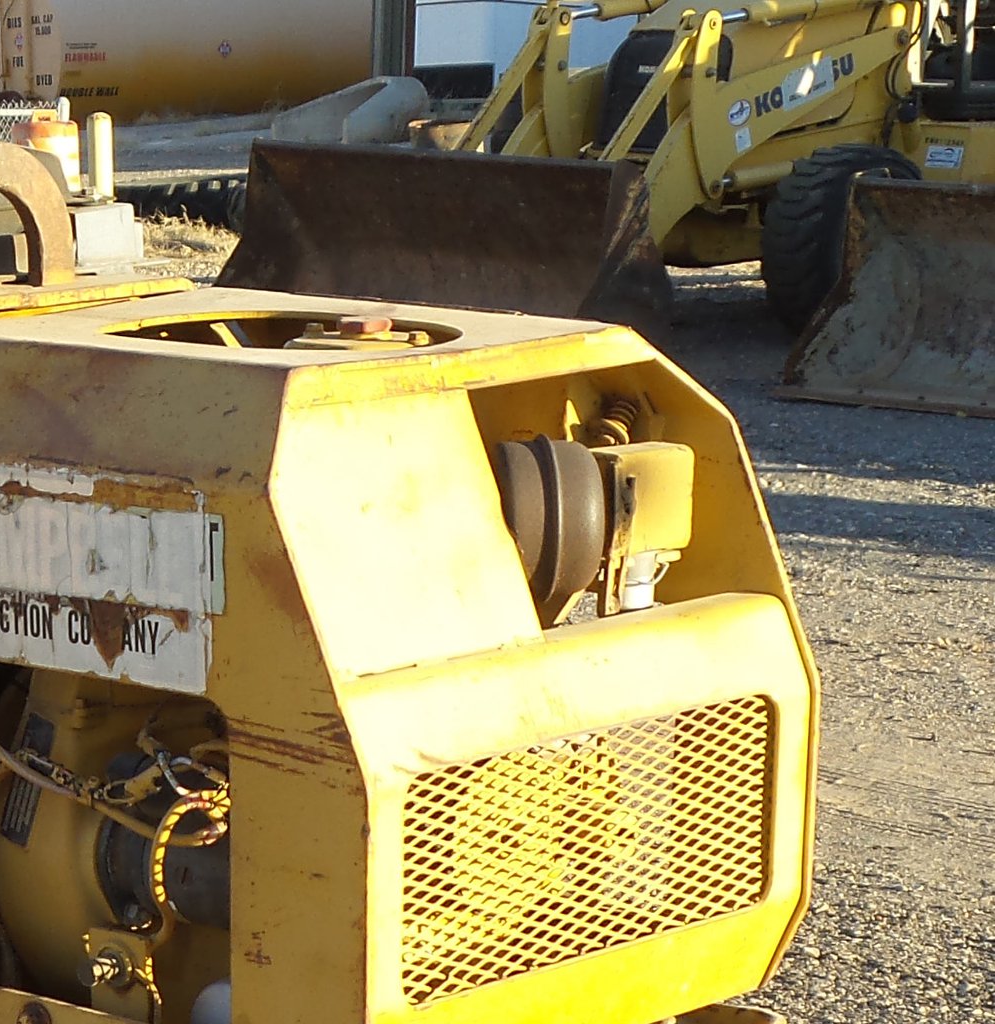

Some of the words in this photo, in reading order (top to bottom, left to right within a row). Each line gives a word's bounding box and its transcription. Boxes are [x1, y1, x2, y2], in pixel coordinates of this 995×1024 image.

[36, 74, 52, 86] DYED
[60, 88, 93, 97] DOUBLE
[68, 609, 160, 655] COANY
